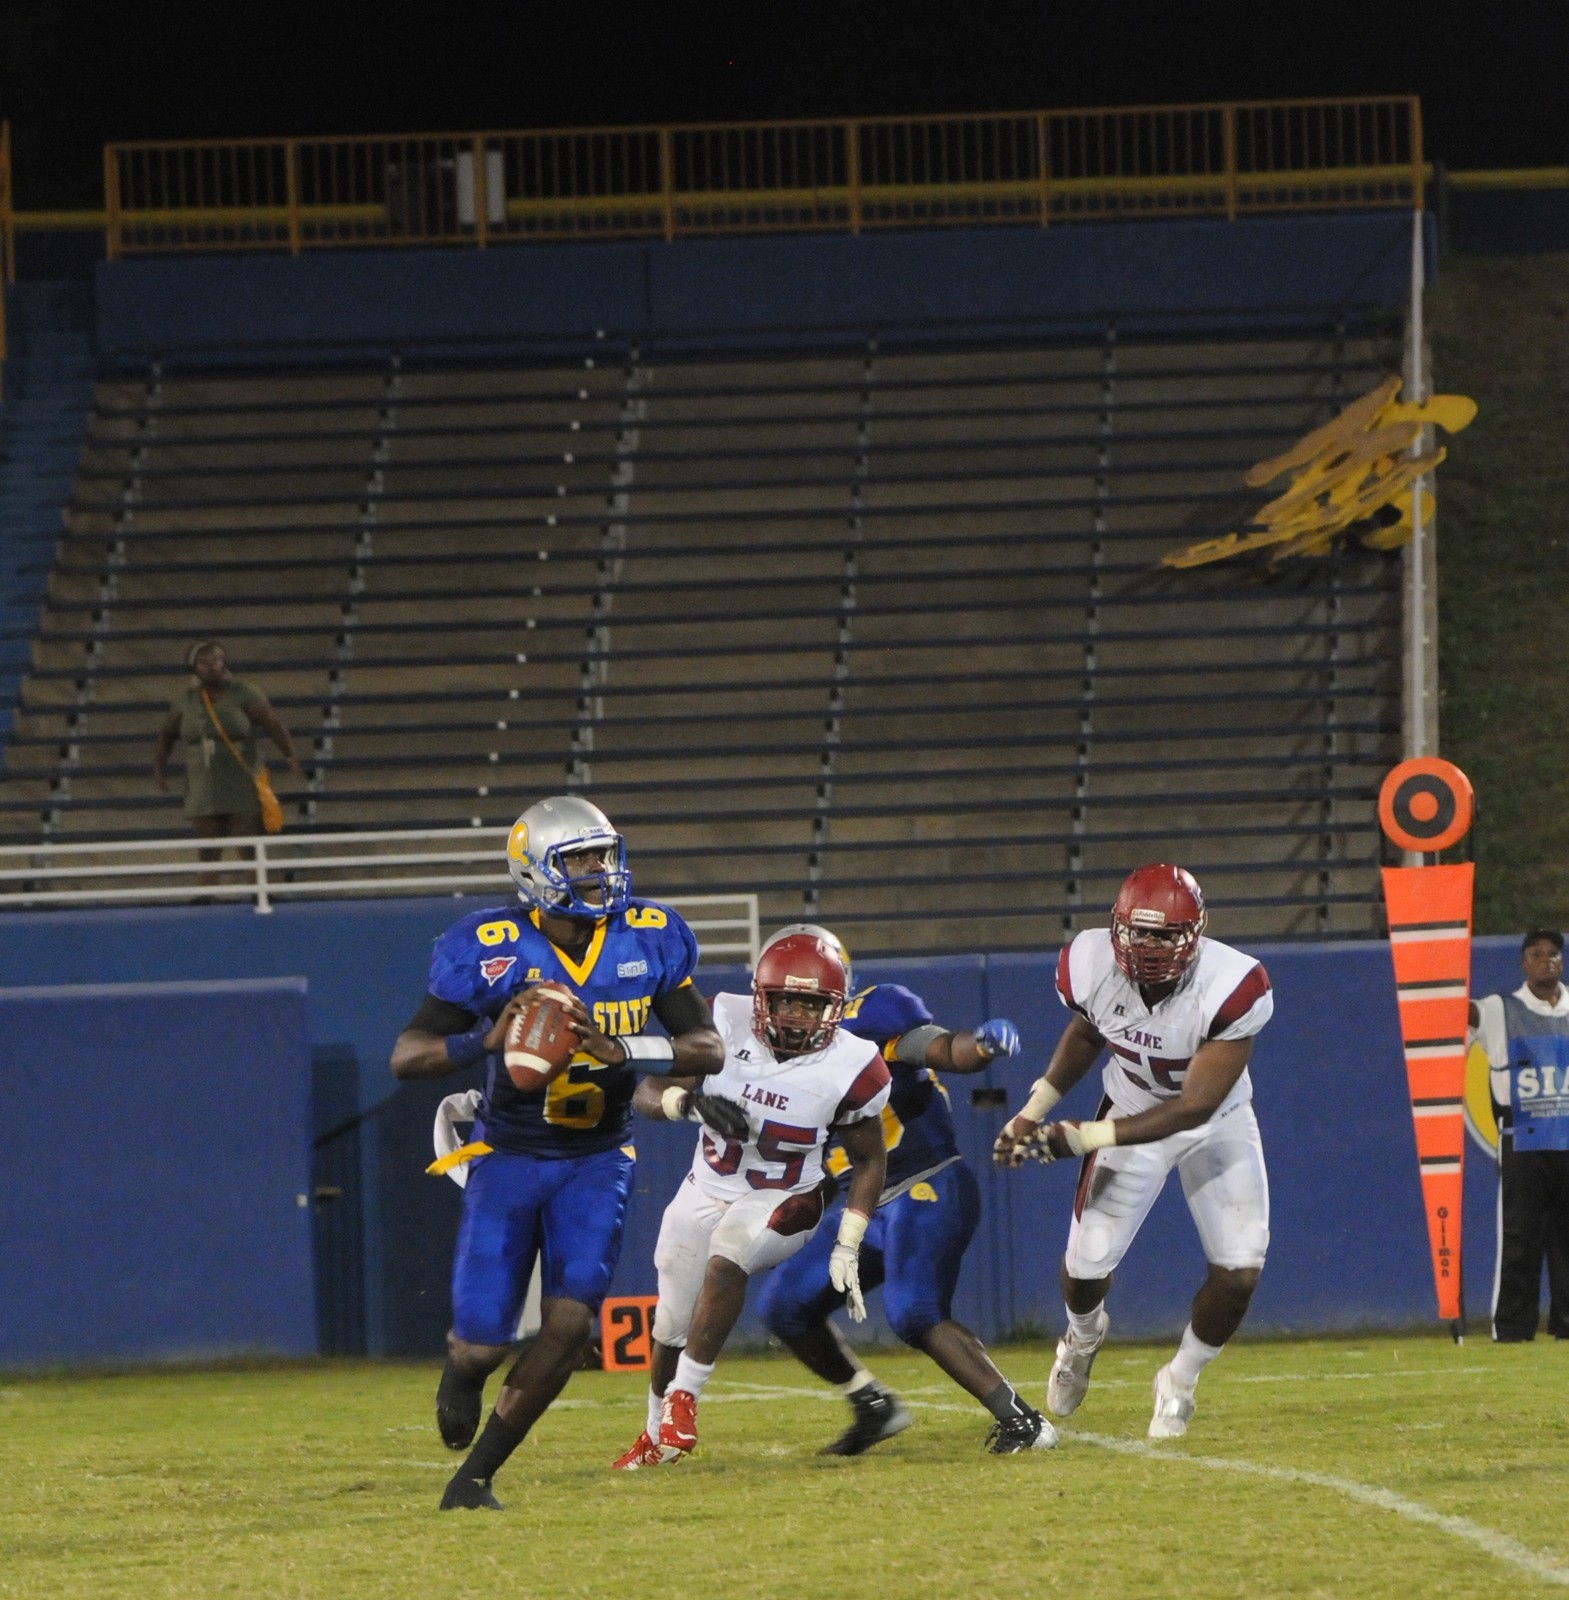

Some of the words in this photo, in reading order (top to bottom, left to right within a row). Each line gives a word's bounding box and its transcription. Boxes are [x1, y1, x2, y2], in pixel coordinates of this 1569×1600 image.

[1124, 1029, 1162, 1050] LANE
[543, 1051, 608, 1129] 6
[741, 1083, 789, 1111] LANE
[1437, 1206, 1450, 1277] Gilman
